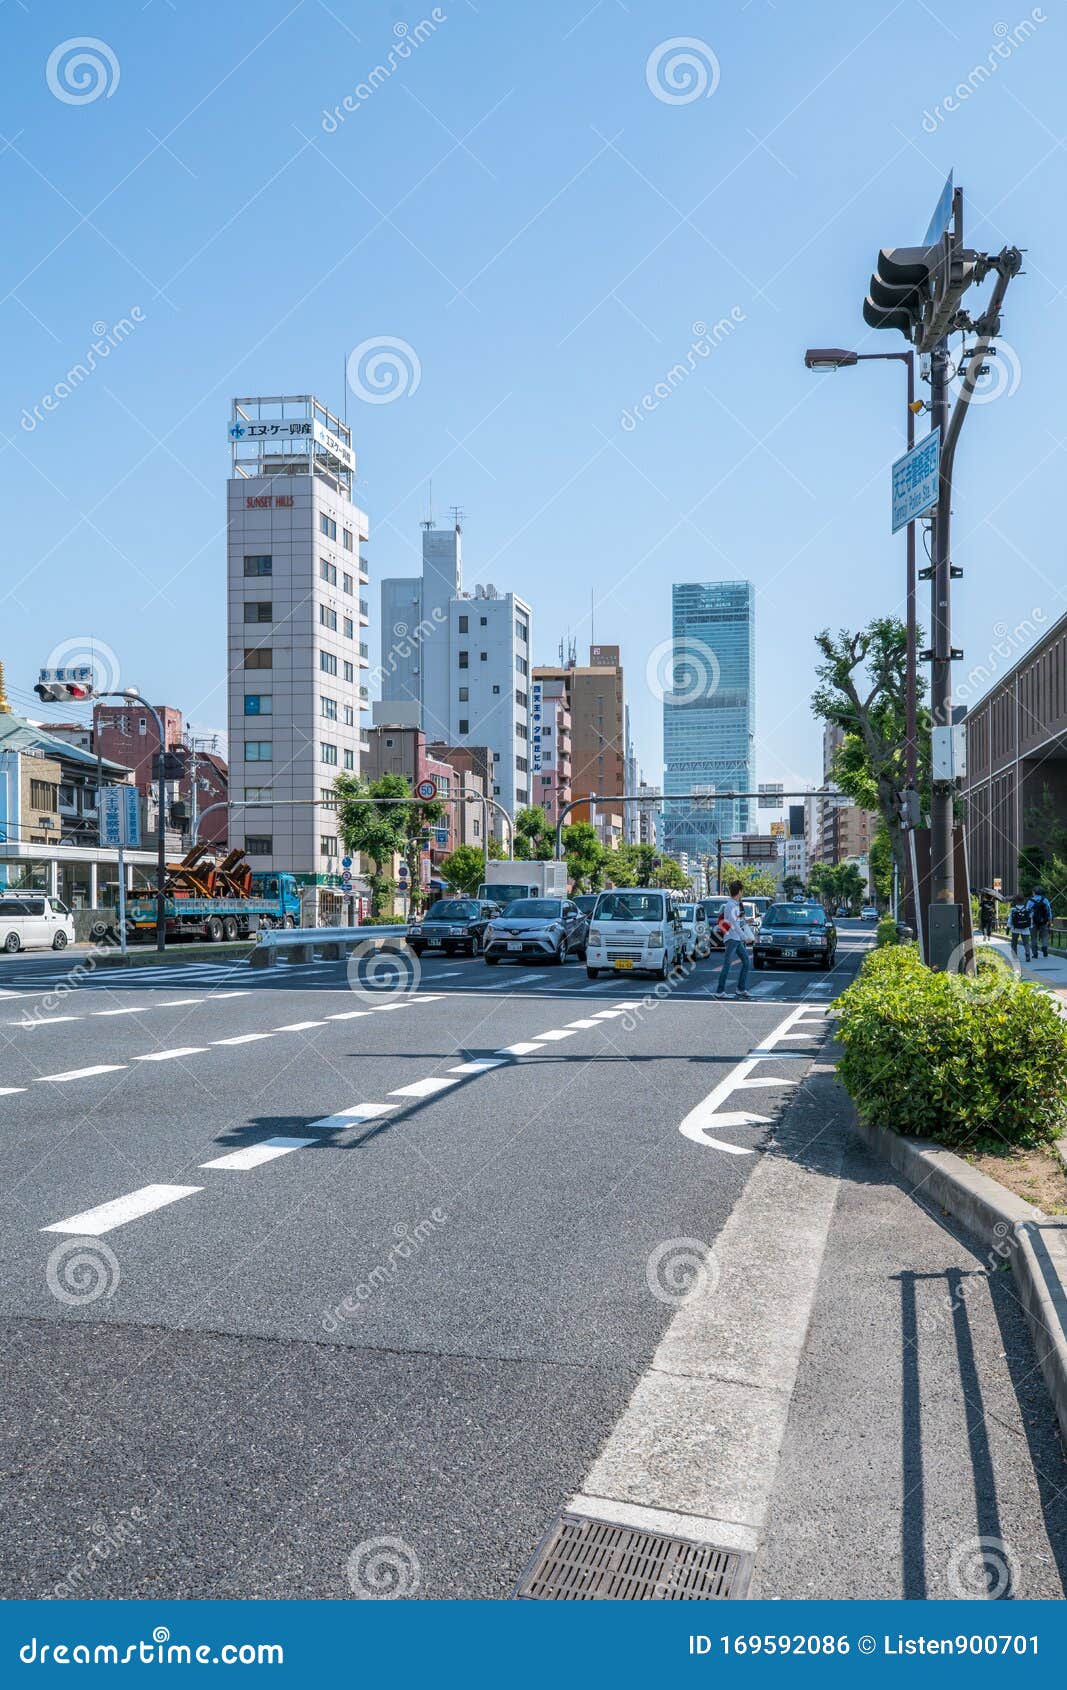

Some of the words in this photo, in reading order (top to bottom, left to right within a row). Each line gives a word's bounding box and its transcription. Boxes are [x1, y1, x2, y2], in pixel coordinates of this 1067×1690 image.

[246, 496, 272, 508] SUNSET
[275, 495, 294, 508] HILLS
[420, 785, 433, 795] 50
